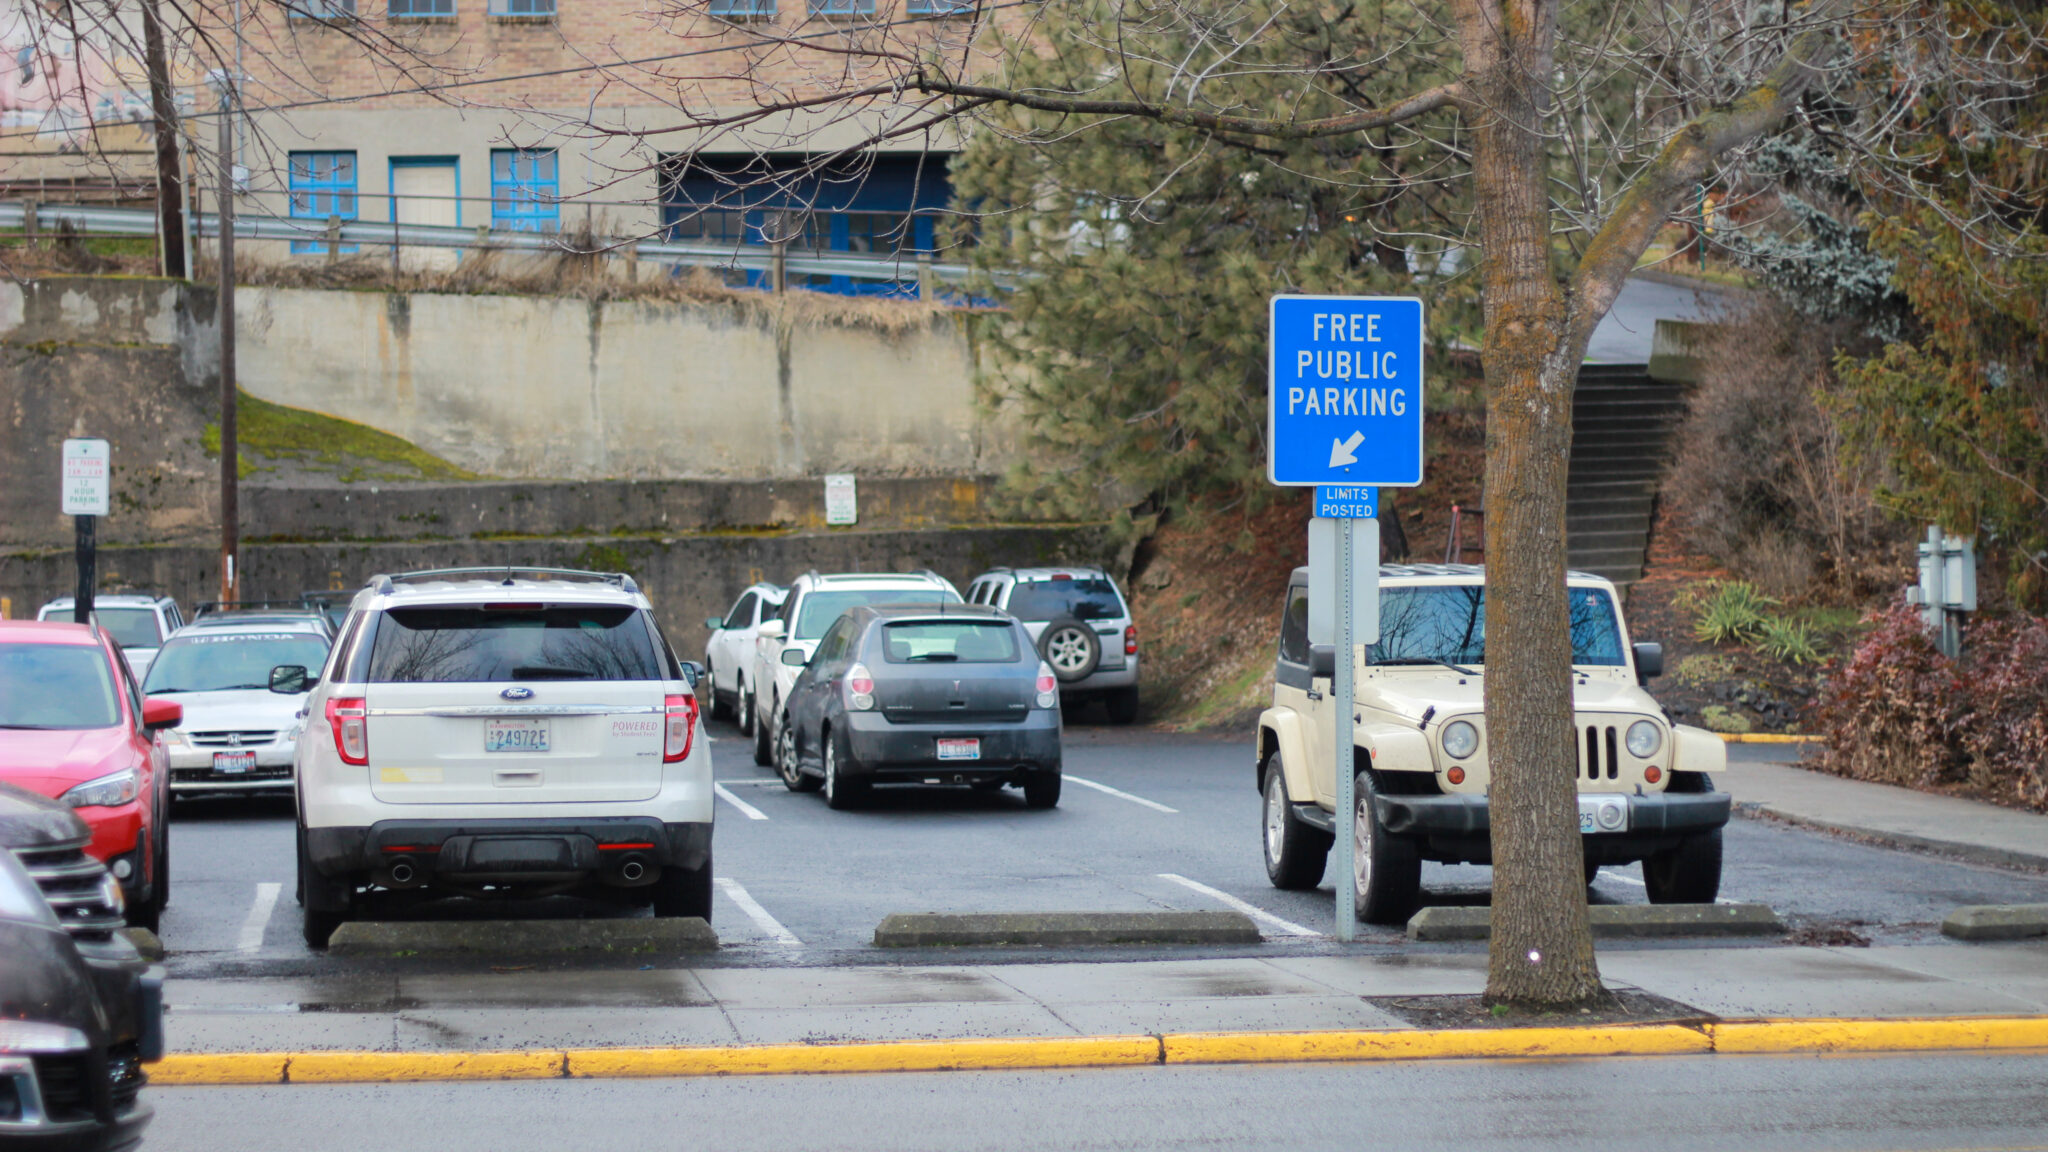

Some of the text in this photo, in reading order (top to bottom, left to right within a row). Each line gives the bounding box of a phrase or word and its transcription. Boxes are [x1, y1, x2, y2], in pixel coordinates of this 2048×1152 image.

[1313, 313, 1381, 342] FREE
[1297, 350, 1397, 379] PUBLIC
[1288, 387, 1406, 416] PARKING
[74, 487, 95, 495] HOUR
[1326, 487, 1369, 500] LIMITS
[1322, 504, 1373, 517] POSTED
[212, 633, 295, 643] HONDA
[612, 721, 658, 731] POWERED
[496, 729, 547, 746] 24972E
